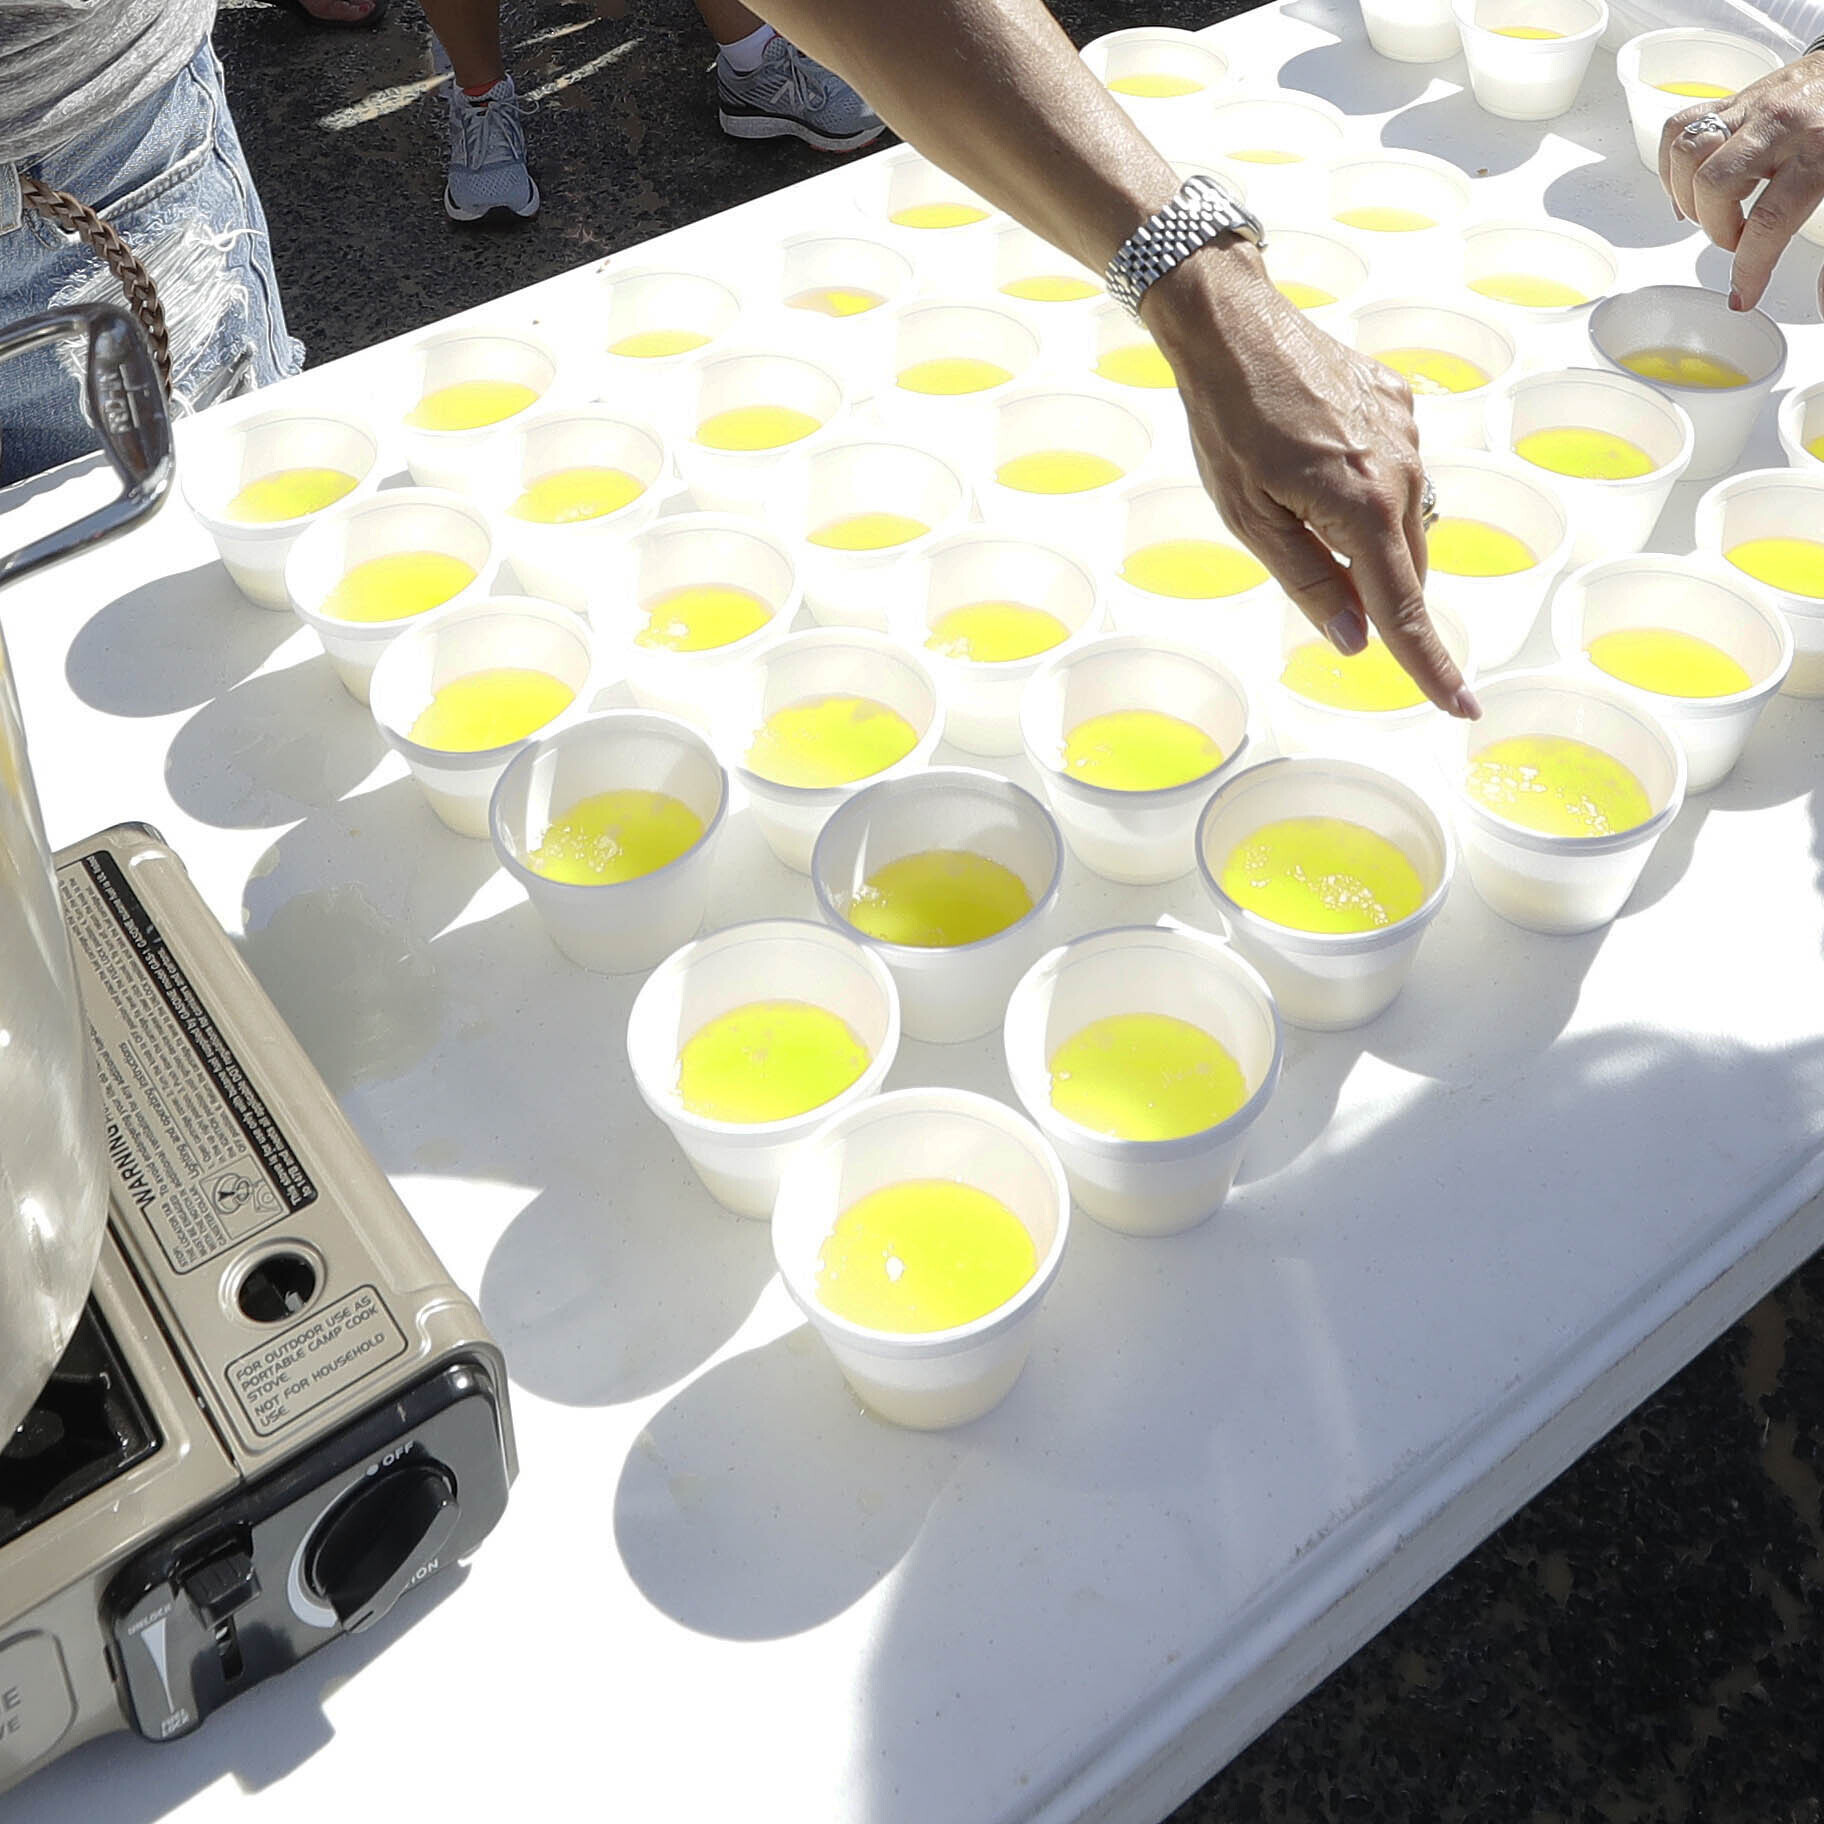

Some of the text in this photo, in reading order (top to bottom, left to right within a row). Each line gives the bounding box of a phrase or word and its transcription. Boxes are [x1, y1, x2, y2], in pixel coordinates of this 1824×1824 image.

[113, 1041, 203, 1180] Lighting and operating instructions
[95, 1122, 159, 1209] WARNING
[236, 1295, 372, 1381] FOR OUTDOOR USE AS
[241, 1306, 379, 1392] PORTABLE CAMP COOK
[254, 1332, 385, 1416] NOT FOR HOUSEHOLD
[381, 1439, 414, 1468] OFF
